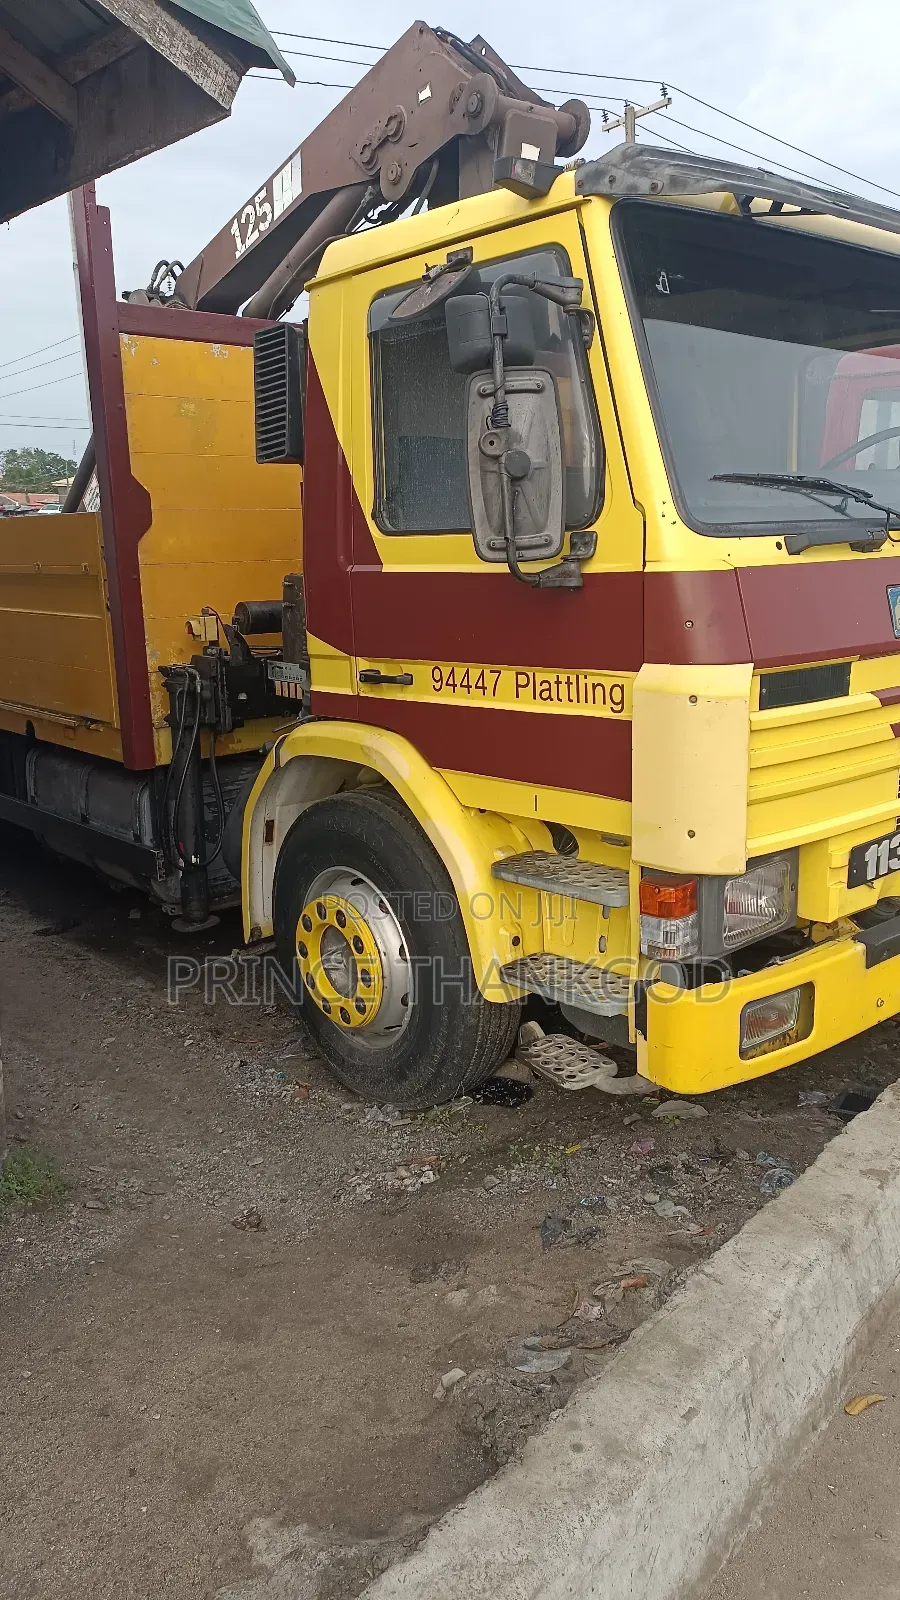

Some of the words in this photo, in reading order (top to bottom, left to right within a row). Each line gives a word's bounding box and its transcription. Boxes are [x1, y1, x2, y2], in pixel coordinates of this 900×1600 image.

[230, 186, 273, 260] 125
[431, 665, 502, 697] 94447
[514, 671, 626, 714] Plattling
